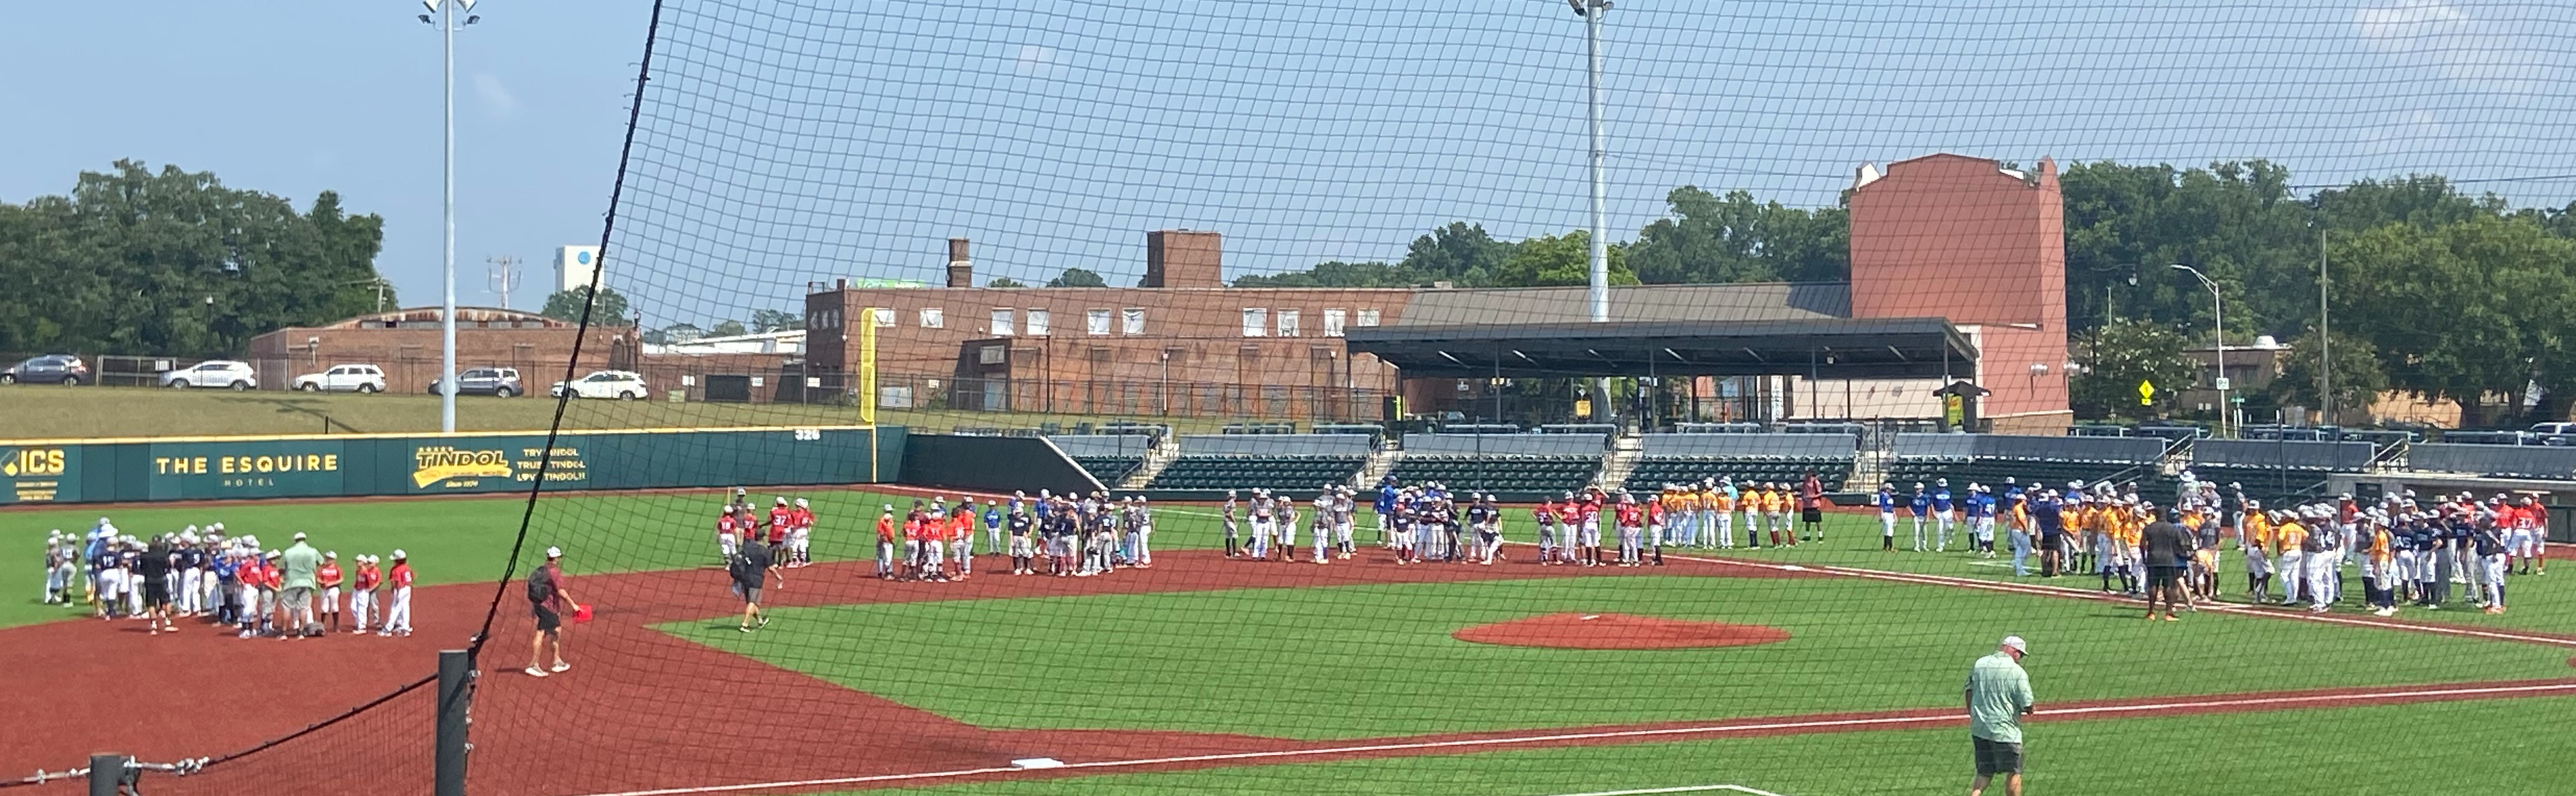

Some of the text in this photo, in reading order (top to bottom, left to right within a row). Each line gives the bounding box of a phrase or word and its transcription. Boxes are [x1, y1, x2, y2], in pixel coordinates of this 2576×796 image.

[20, 449, 65, 473] ICS
[156, 454, 338, 475] THE ESQUIRE
[416, 450, 509, 469] TINDOL
[517, 461, 544, 469] TRUS
[224, 478, 274, 487] HOTEL
